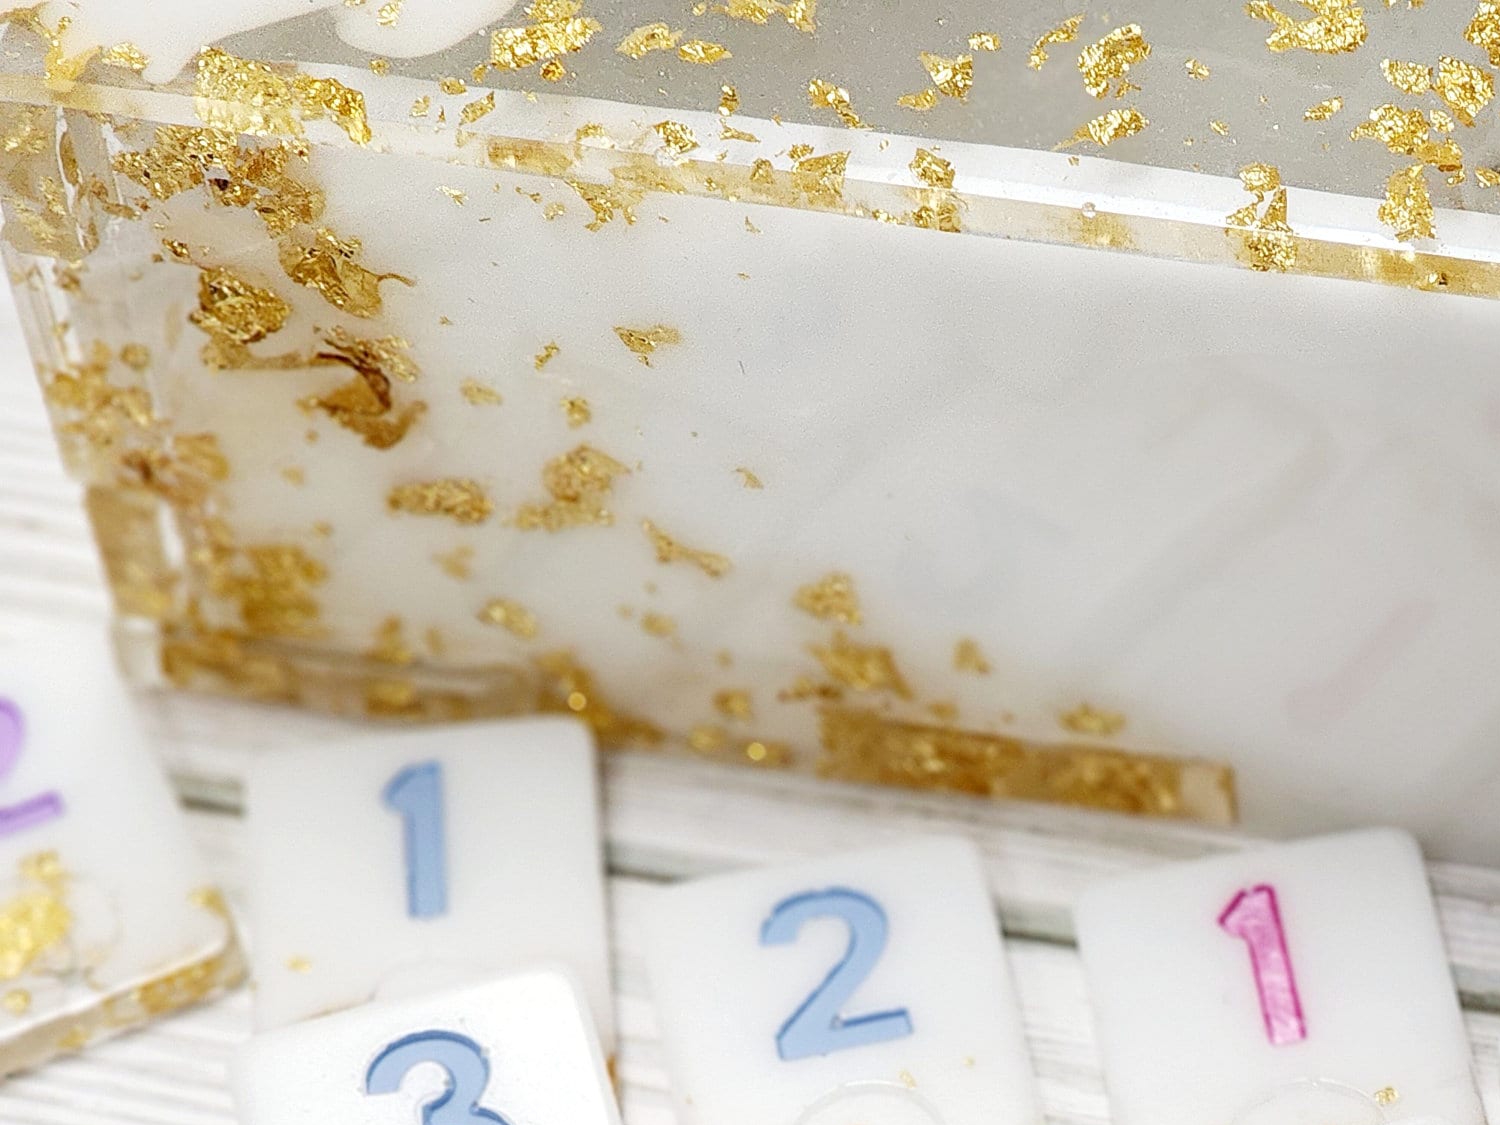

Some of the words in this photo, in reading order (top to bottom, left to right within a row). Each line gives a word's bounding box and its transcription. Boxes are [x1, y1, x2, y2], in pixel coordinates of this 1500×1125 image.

[382, 760, 448, 920] 1
[760, 886, 913, 1061] 2
[1219, 884, 1308, 1043] 1
